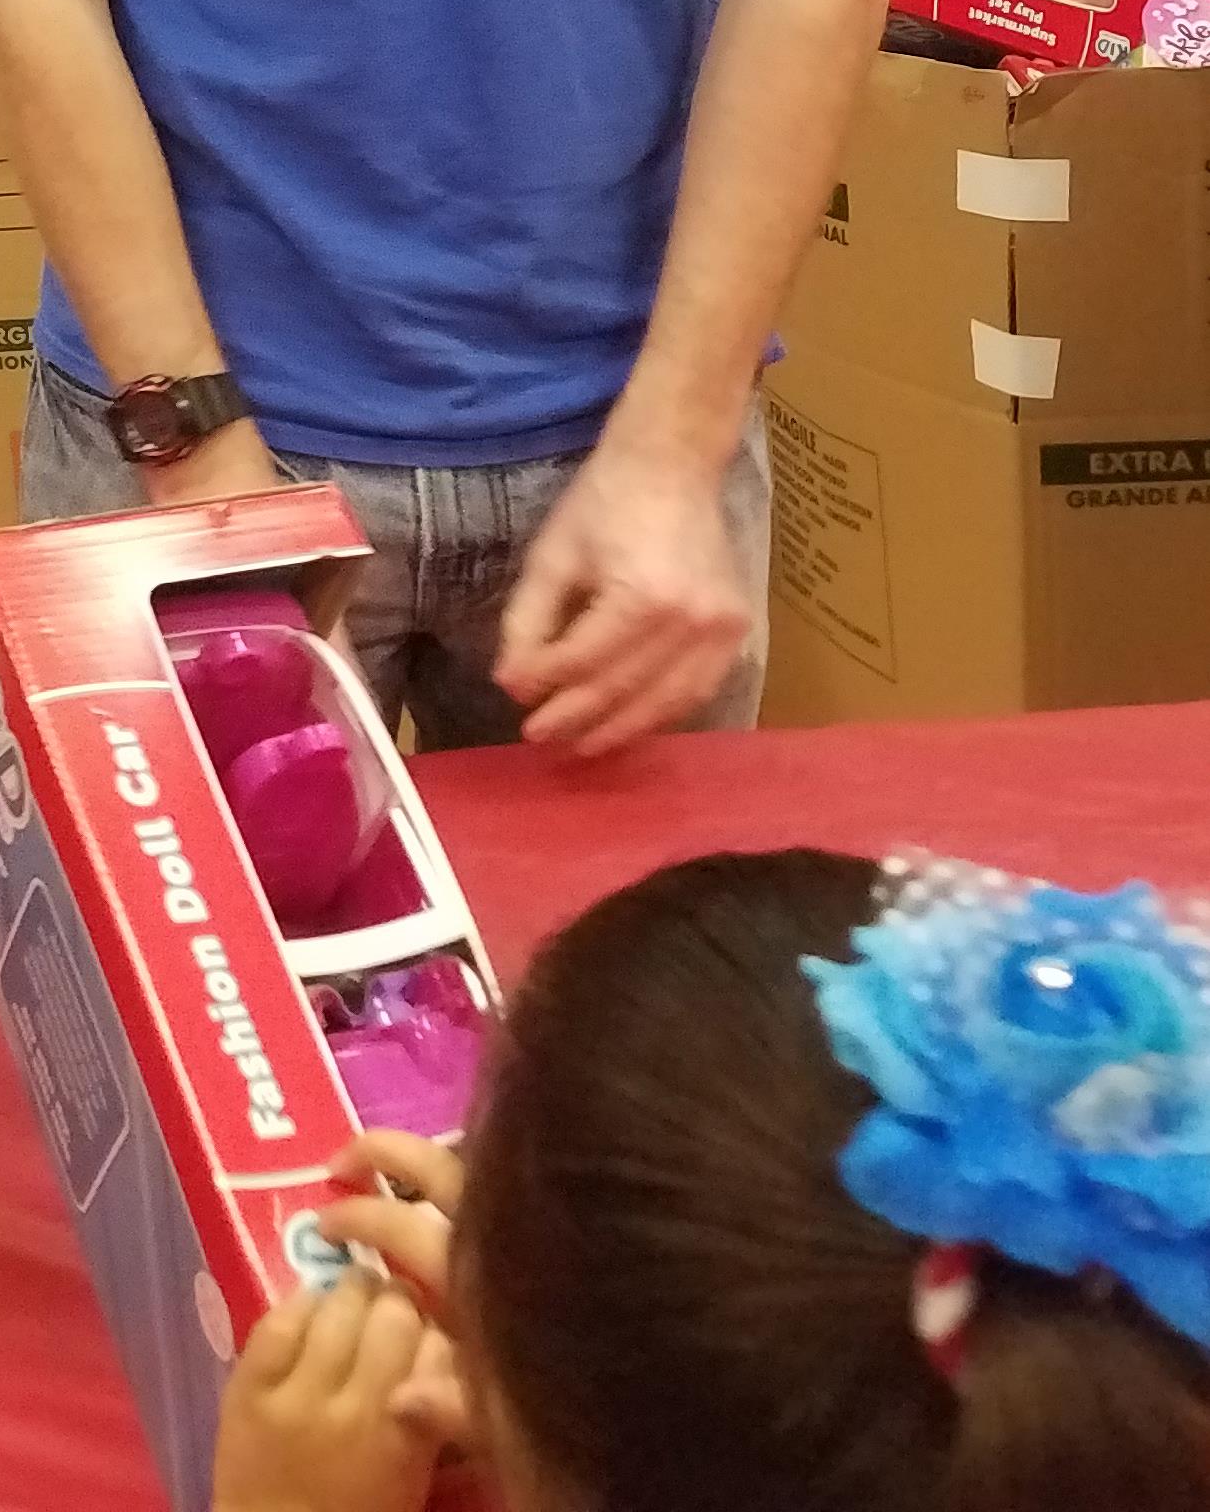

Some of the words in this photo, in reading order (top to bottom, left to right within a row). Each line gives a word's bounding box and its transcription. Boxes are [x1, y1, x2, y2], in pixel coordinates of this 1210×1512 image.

[968, 6, 1056, 47] Supermarket
[1013, 1, 1044, 25] Play
[769, 399, 817, 454] FRAGILE
[1090, 450, 1193, 475] EXTRA
[1065, 488, 1179, 509] GRANDE
[102, 722, 160, 808] Car
[134, 815, 209, 925] Doll
[191, 933, 298, 1140] Fashion
